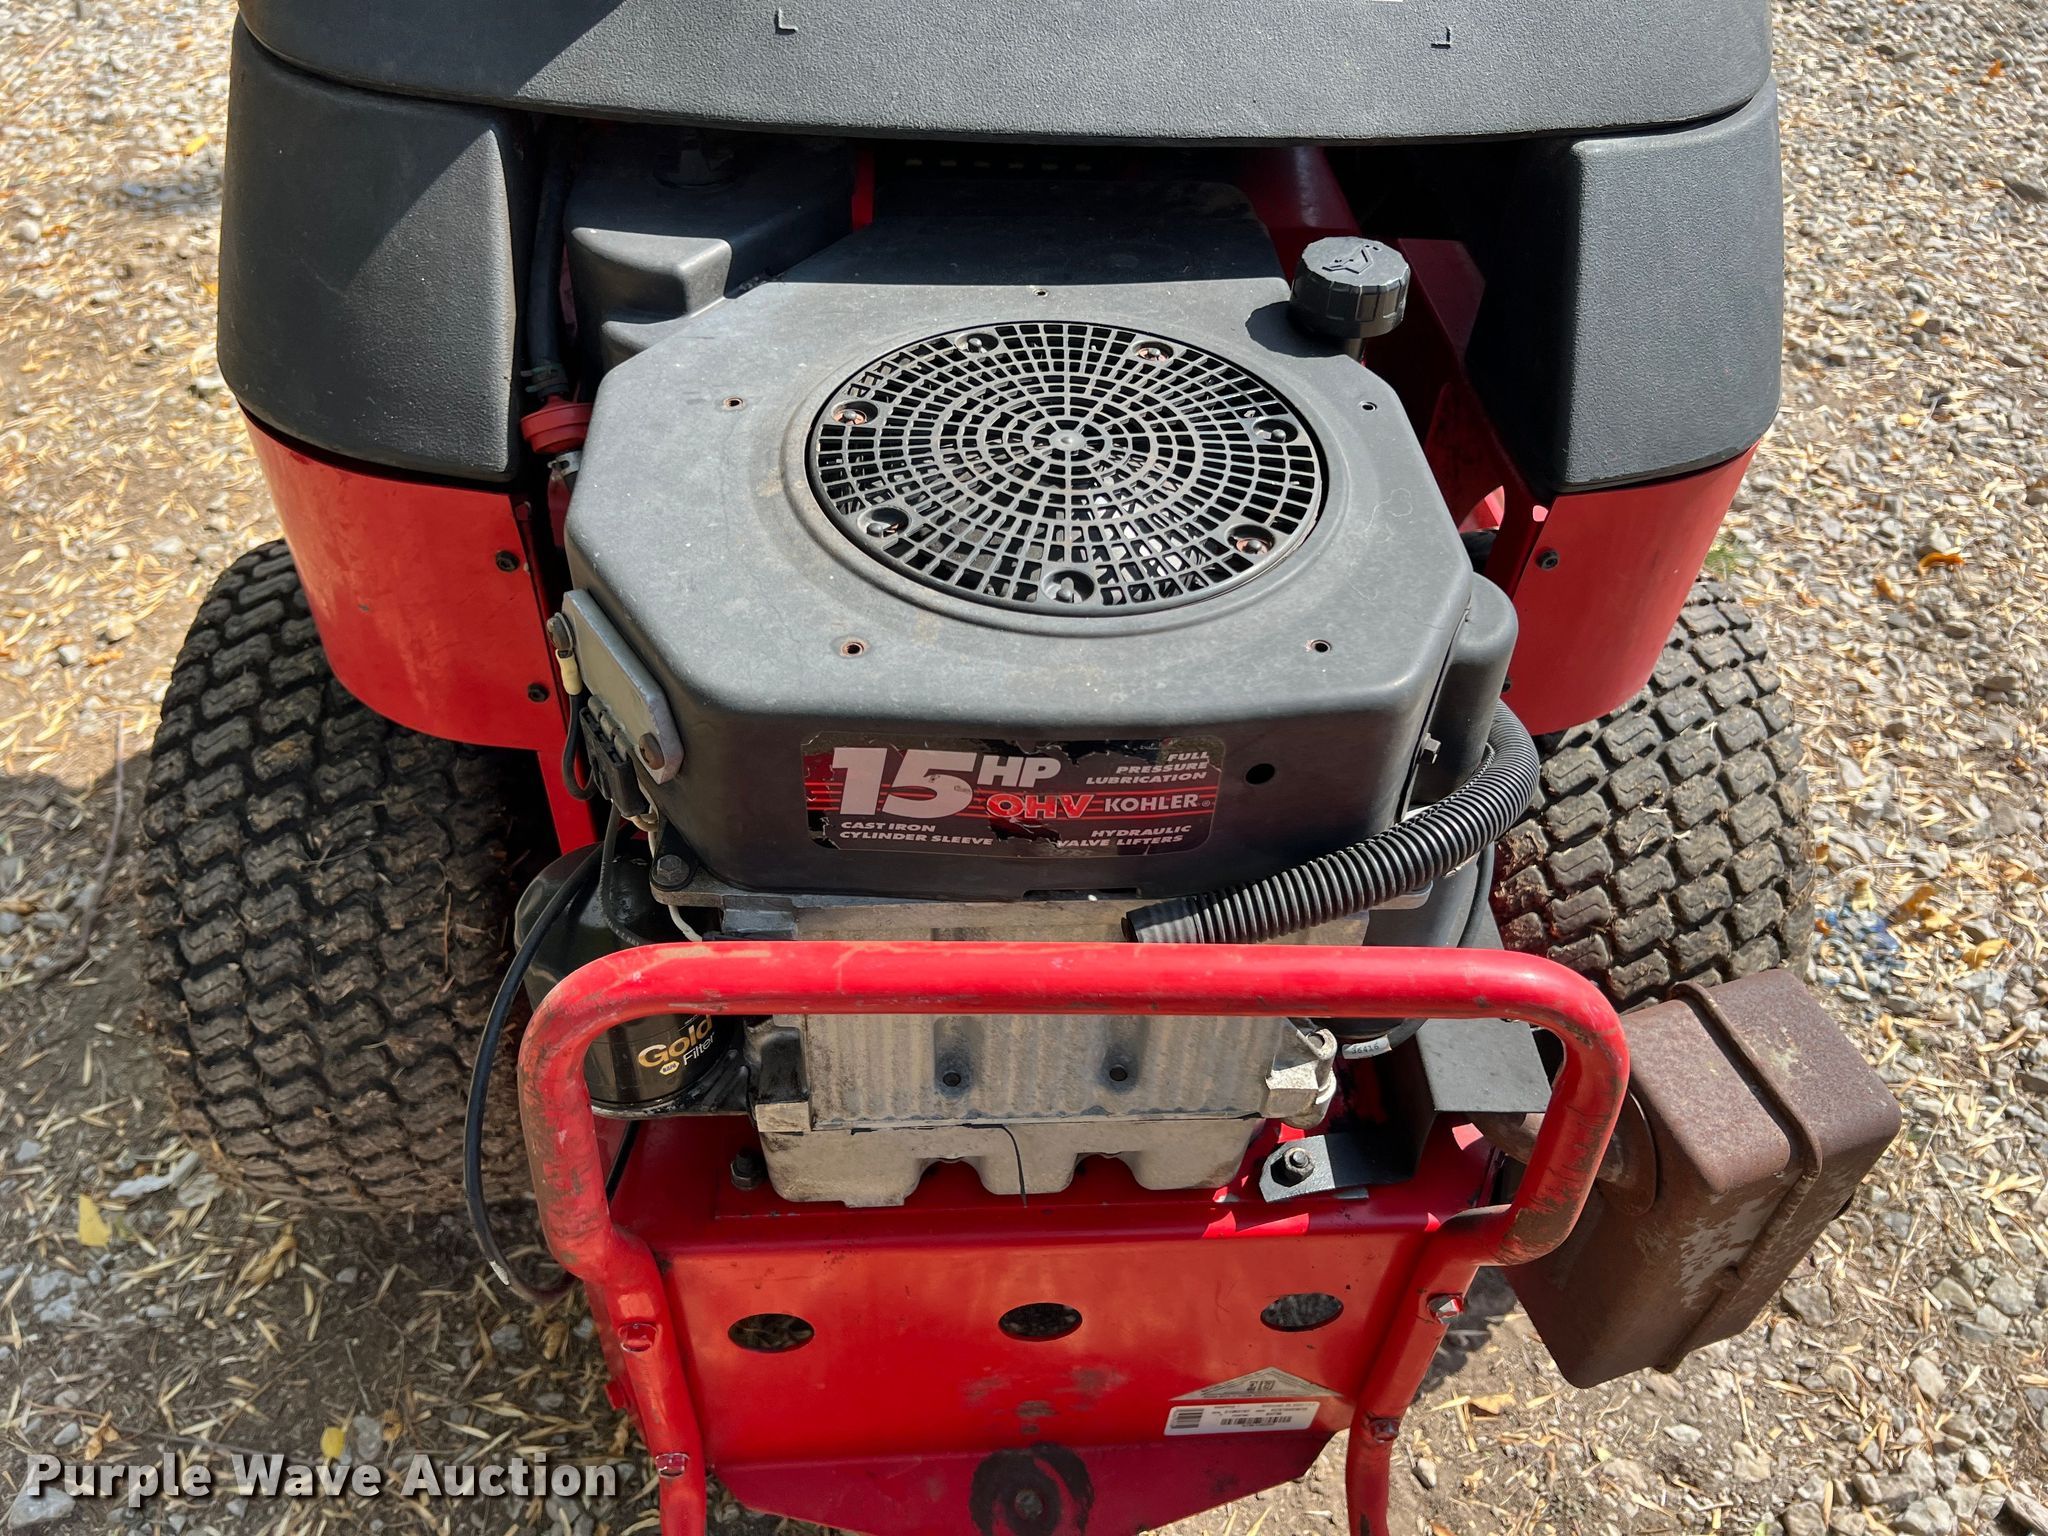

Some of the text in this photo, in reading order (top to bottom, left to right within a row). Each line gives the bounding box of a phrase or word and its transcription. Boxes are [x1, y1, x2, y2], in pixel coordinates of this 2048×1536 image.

[1168, 751, 1209, 762] FULL
[1116, 761, 1208, 774] PRESSURE
[832, 747, 1061, 819] 15 HP
[1085, 772, 1207, 785] LUBRICATION
[986, 793, 1094, 819] OHV
[841, 821, 936, 832] CAST IRON
[1091, 825, 1192, 837] HYDRAULIC
[840, 831, 994, 846] CYLINDER SLEEVE
[1057, 835, 1184, 848] VALVE LIFTERS
[638, 1014, 712, 1068] Gold
[683, 1031, 715, 1065] Filter
